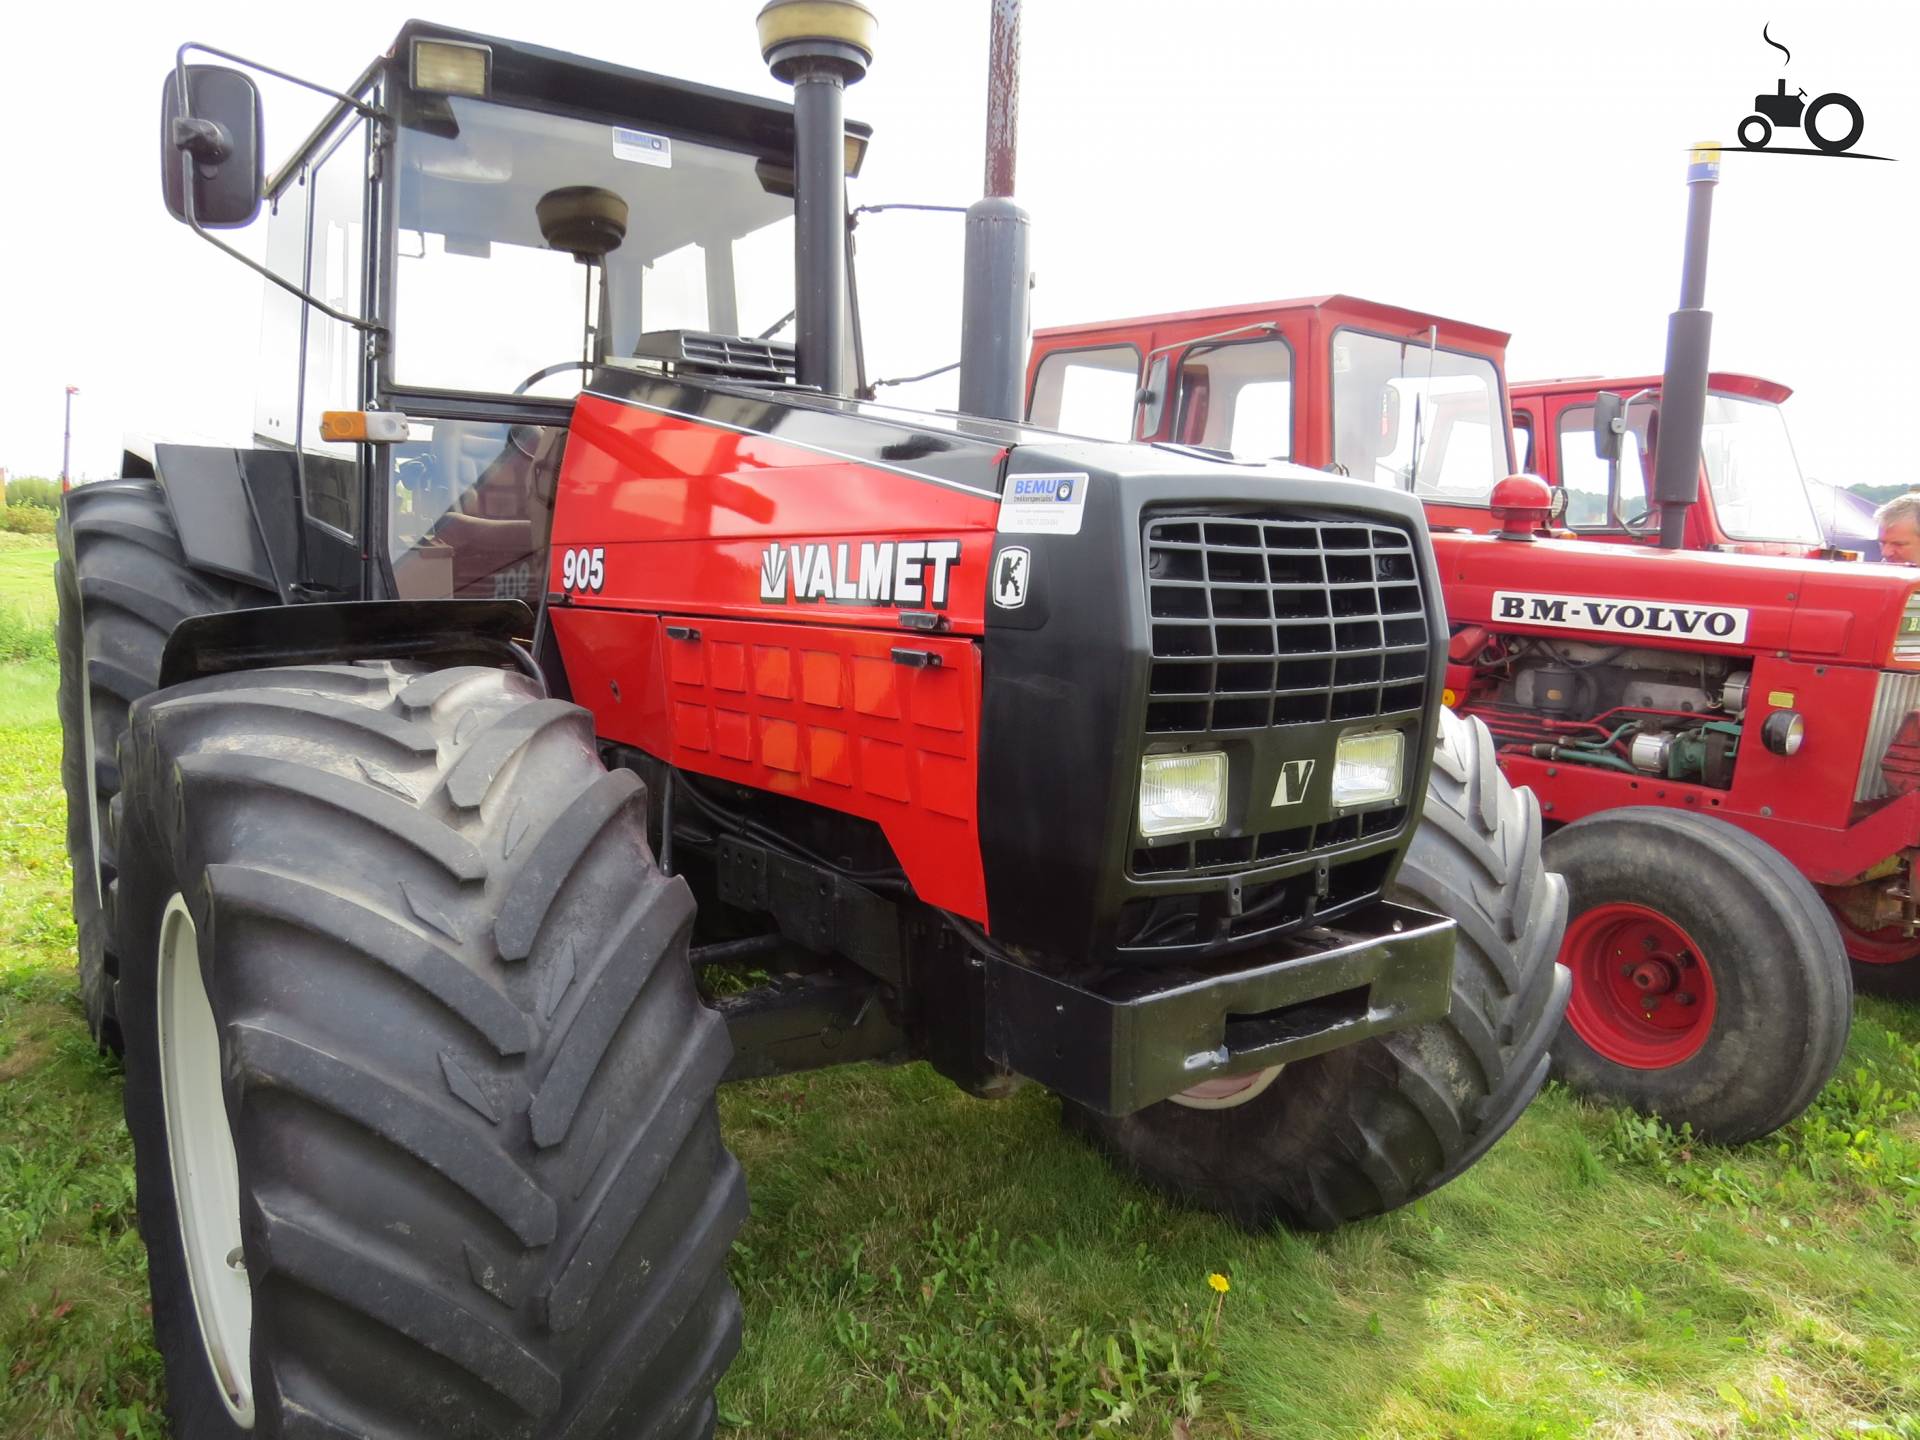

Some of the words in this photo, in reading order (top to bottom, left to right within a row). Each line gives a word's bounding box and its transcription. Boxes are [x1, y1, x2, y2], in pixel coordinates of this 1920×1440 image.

[1014, 479, 1057, 495] BEMU
[562, 547, 605, 593] 905
[790, 540, 962, 610] VALMET
[1499, 595, 1737, 637] BM-VOLVO
